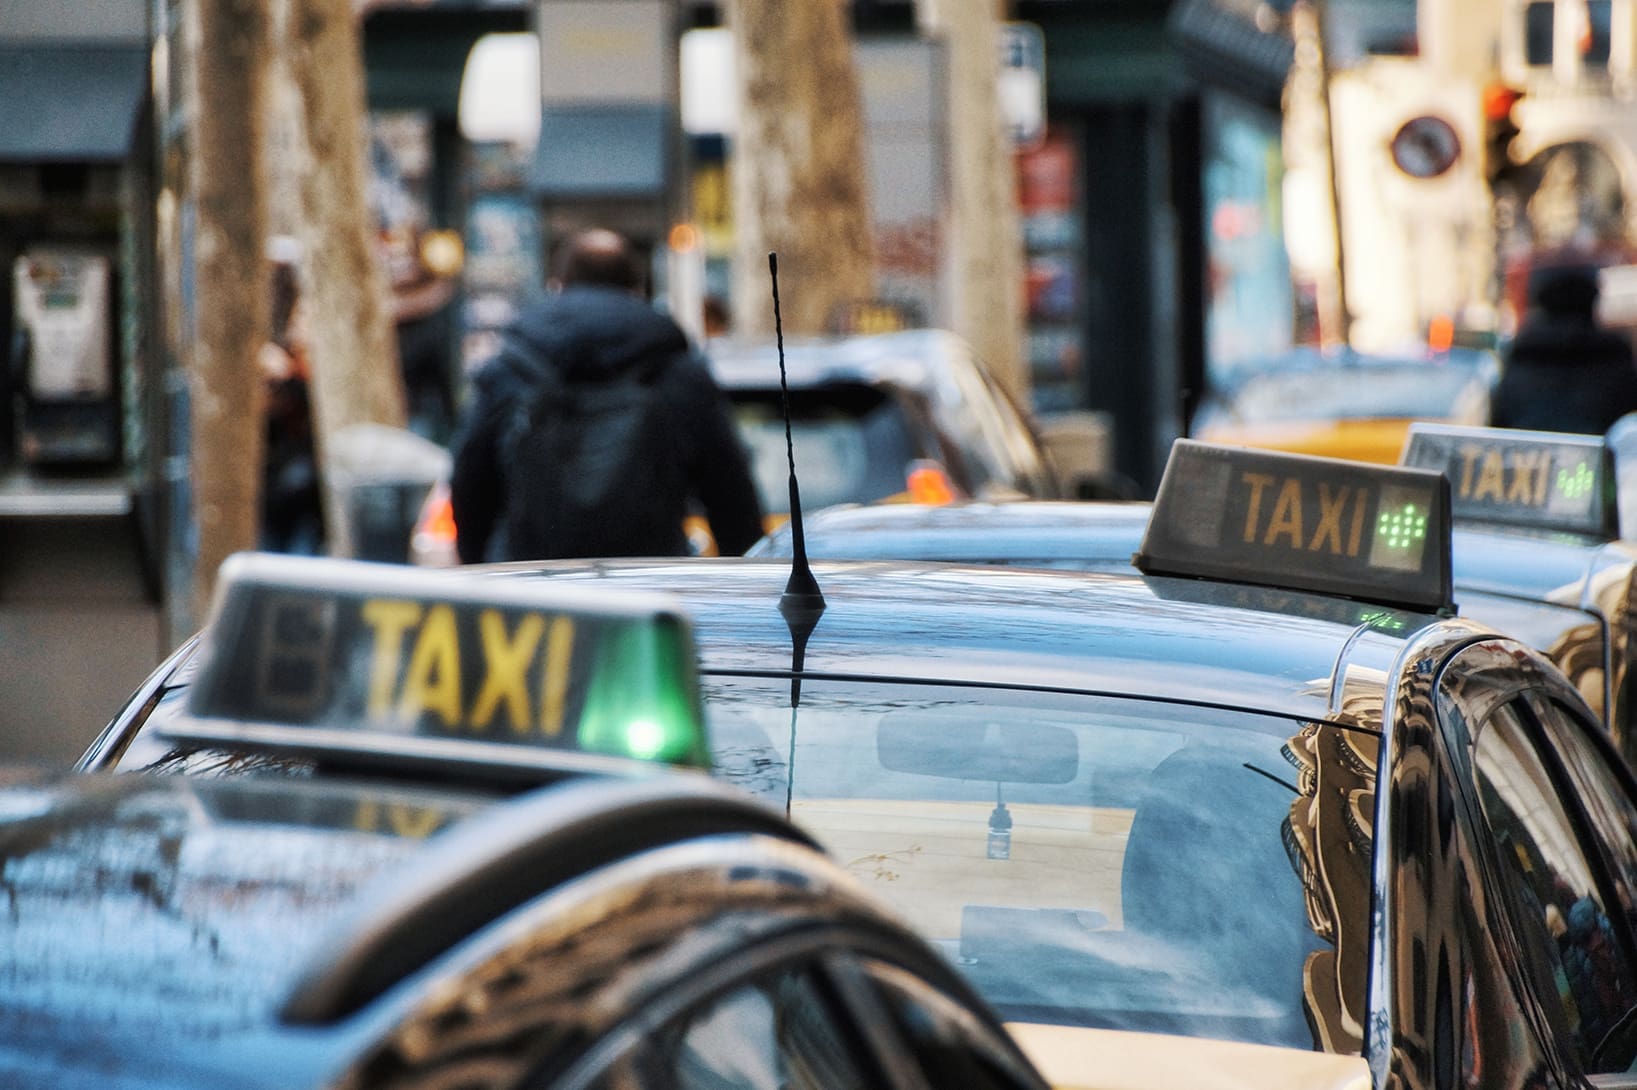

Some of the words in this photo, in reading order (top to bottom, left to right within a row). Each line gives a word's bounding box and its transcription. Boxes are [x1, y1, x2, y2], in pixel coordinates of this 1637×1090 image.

[1242, 472, 1369, 557] TAXI
[1459, 443, 1551, 506] TAXI
[361, 600, 576, 737] TAXI
